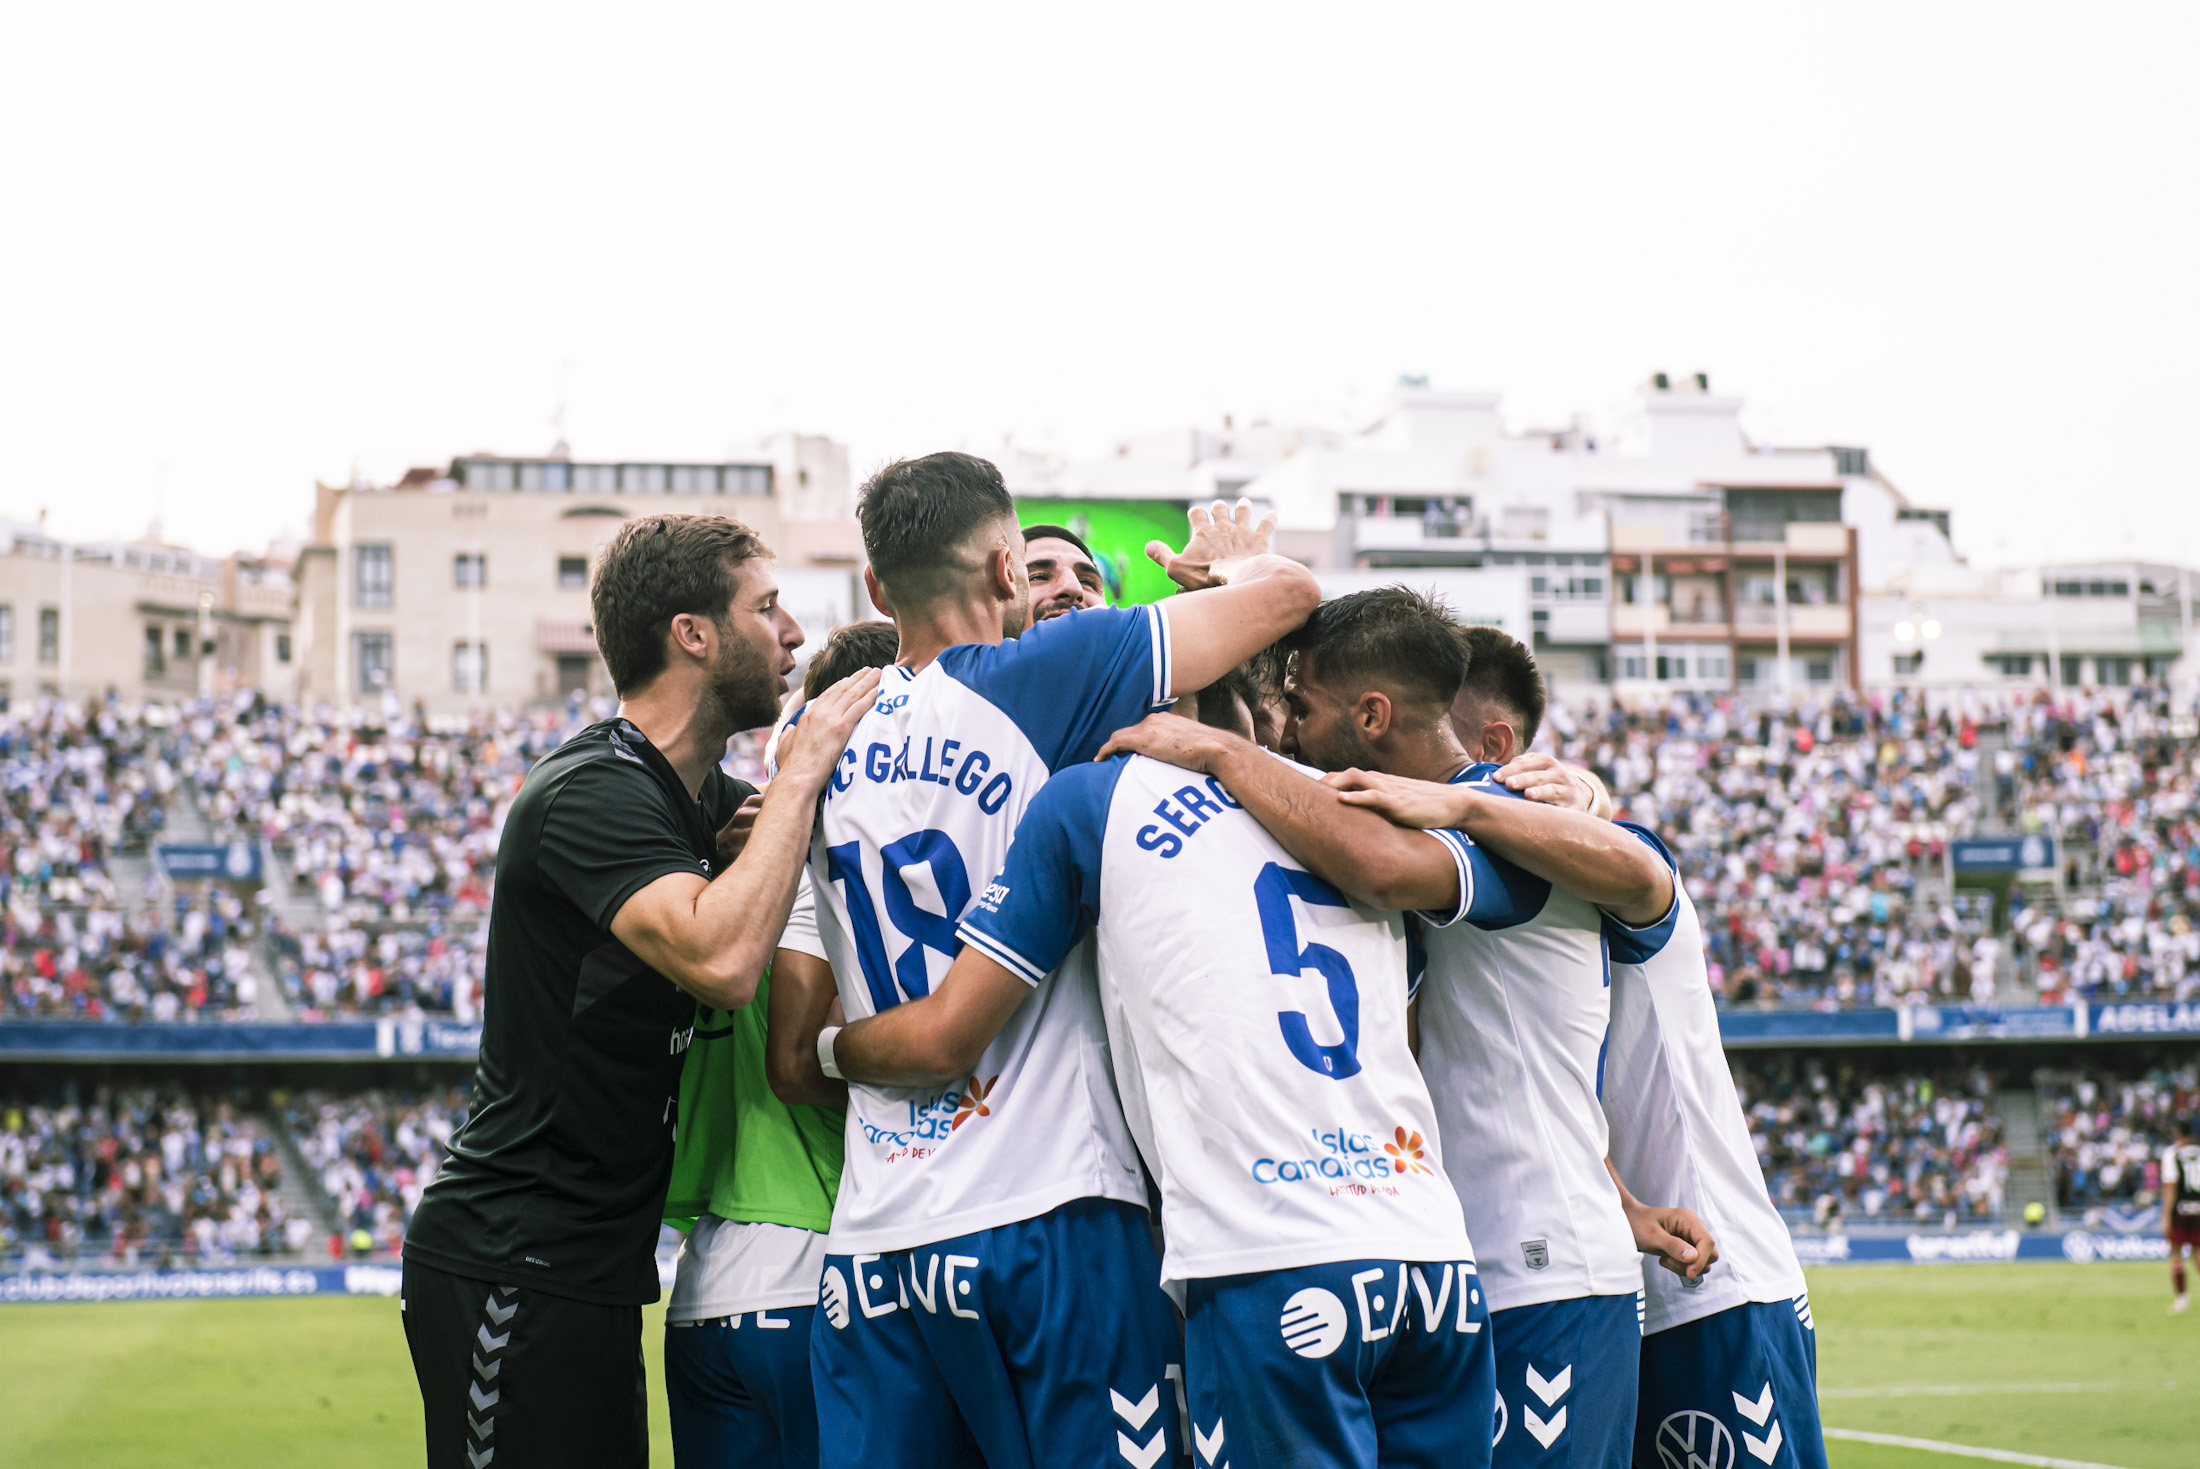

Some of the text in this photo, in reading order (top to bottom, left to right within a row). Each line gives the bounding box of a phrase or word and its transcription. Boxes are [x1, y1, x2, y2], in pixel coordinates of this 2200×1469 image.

[865, 735, 1012, 816] GALLEGO
[1136, 776, 1244, 859] SERG
[826, 829, 972, 1014] 18
[1253, 861, 1363, 1081] 5
